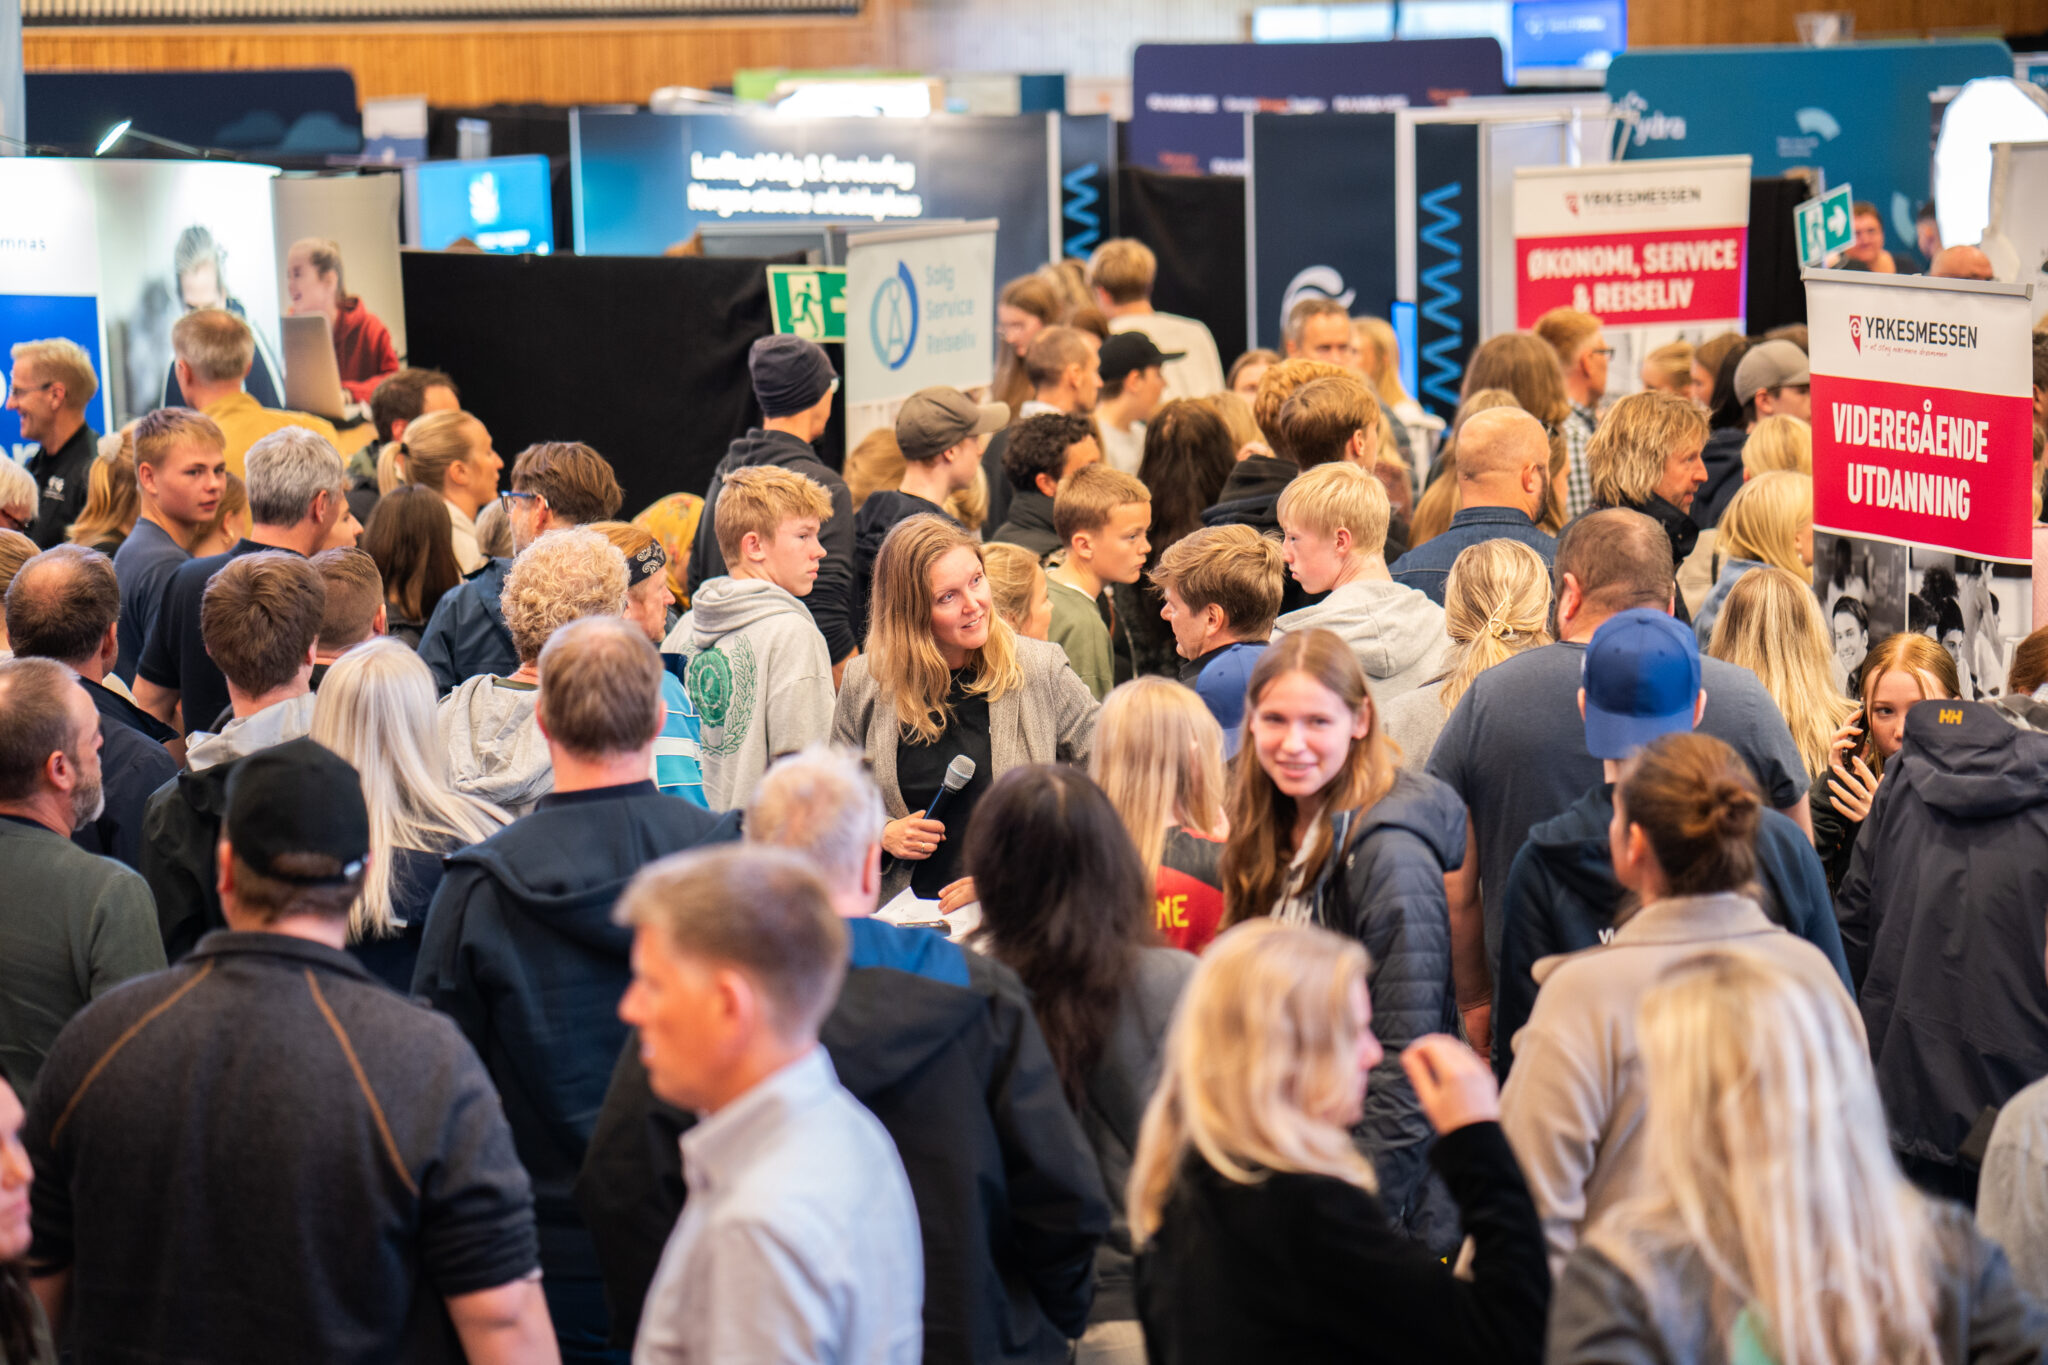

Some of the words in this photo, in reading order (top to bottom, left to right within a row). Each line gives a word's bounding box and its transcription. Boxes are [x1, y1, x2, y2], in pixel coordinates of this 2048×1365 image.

[1584, 187, 1702, 206] YRKESMESSEN
[1527, 244, 1641, 281] ØKONOMI,
[1643, 238, 1738, 274] SERVICE
[926, 297, 975, 321] Service
[1573, 283, 1591, 314] &
[1593, 277, 1695, 314] REISELIV
[1865, 316, 1978, 349] YRKESMESSEN
[1832, 398, 1990, 463] VIDEREGÅENDE
[1847, 463, 1971, 521] UTDANNING
[1938, 708, 1964, 725] HH
